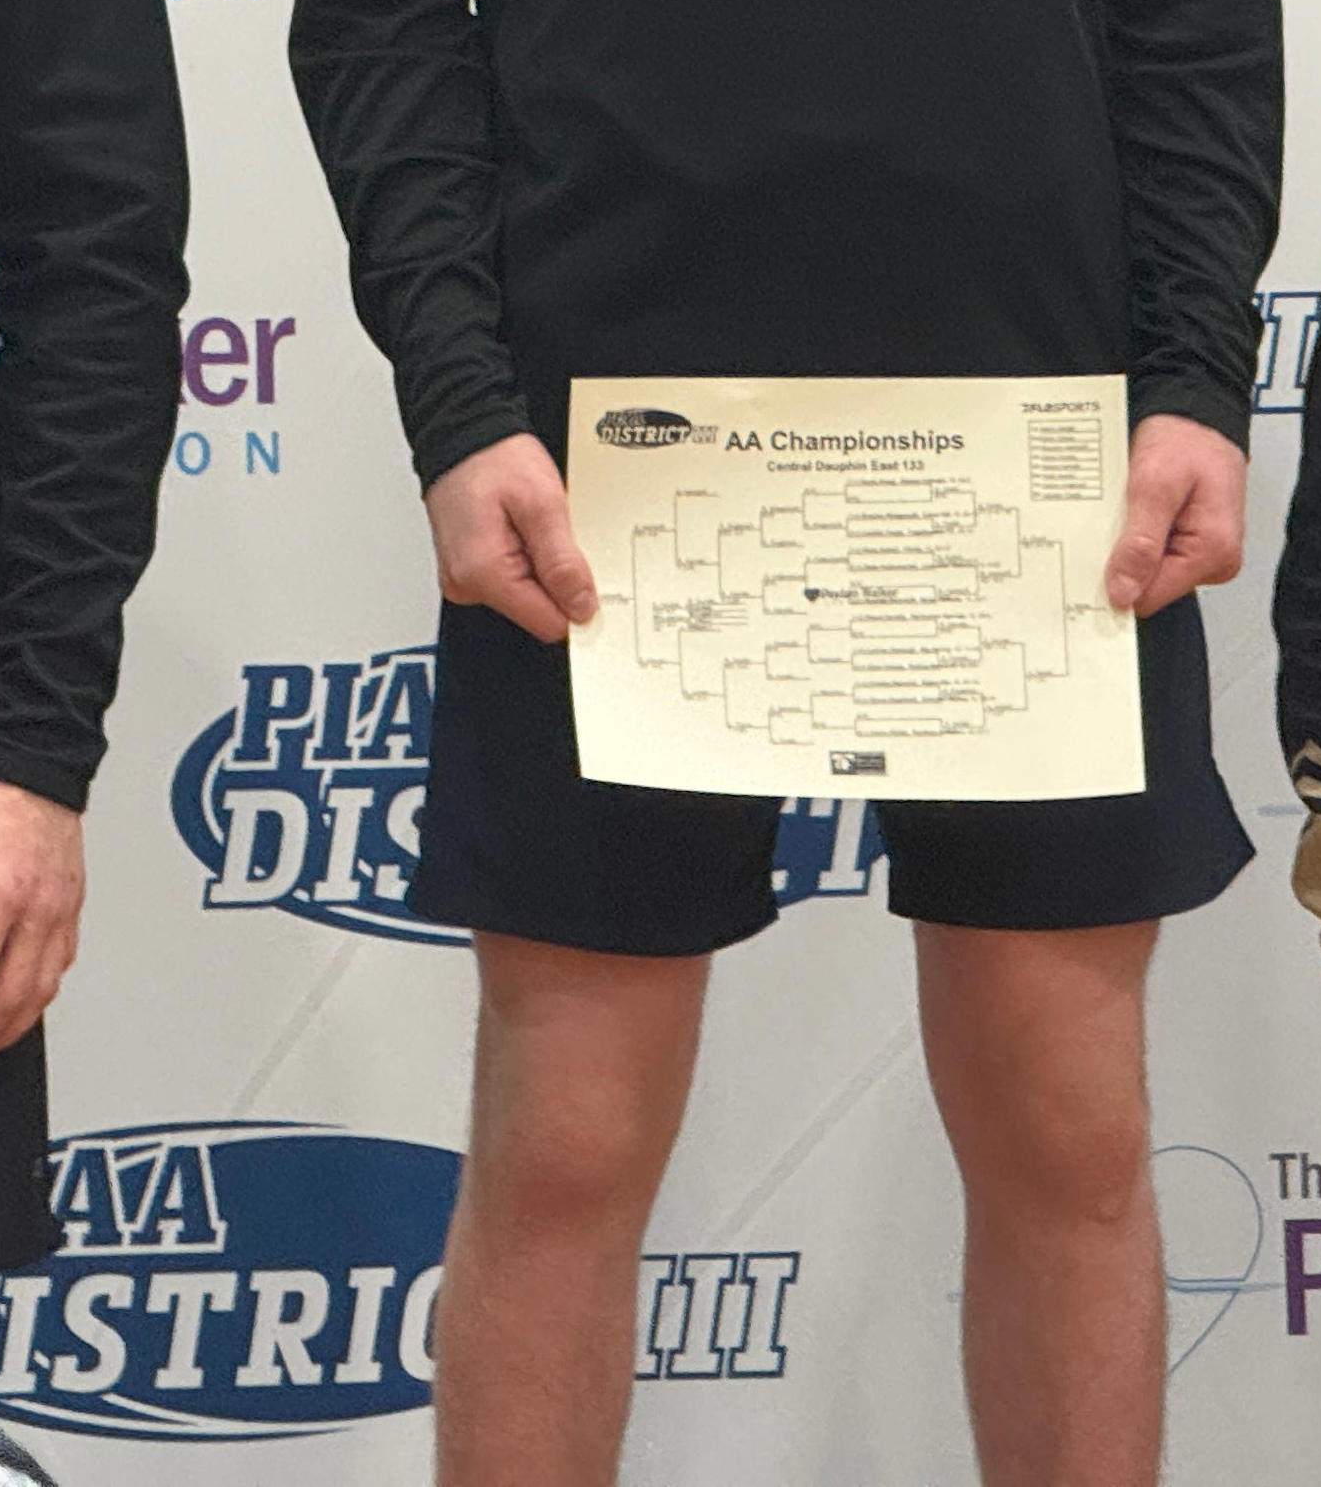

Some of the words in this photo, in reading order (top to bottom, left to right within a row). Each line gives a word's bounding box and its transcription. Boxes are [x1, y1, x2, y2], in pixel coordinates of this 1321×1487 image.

[598, 425, 690, 444] DISTRICT
[725, 430, 763, 451] AA
[770, 430, 965, 454] Championships
[767, 460, 813, 473] Central
[816, 460, 867, 474] Dauphin
[871, 460, 899, 473] East
